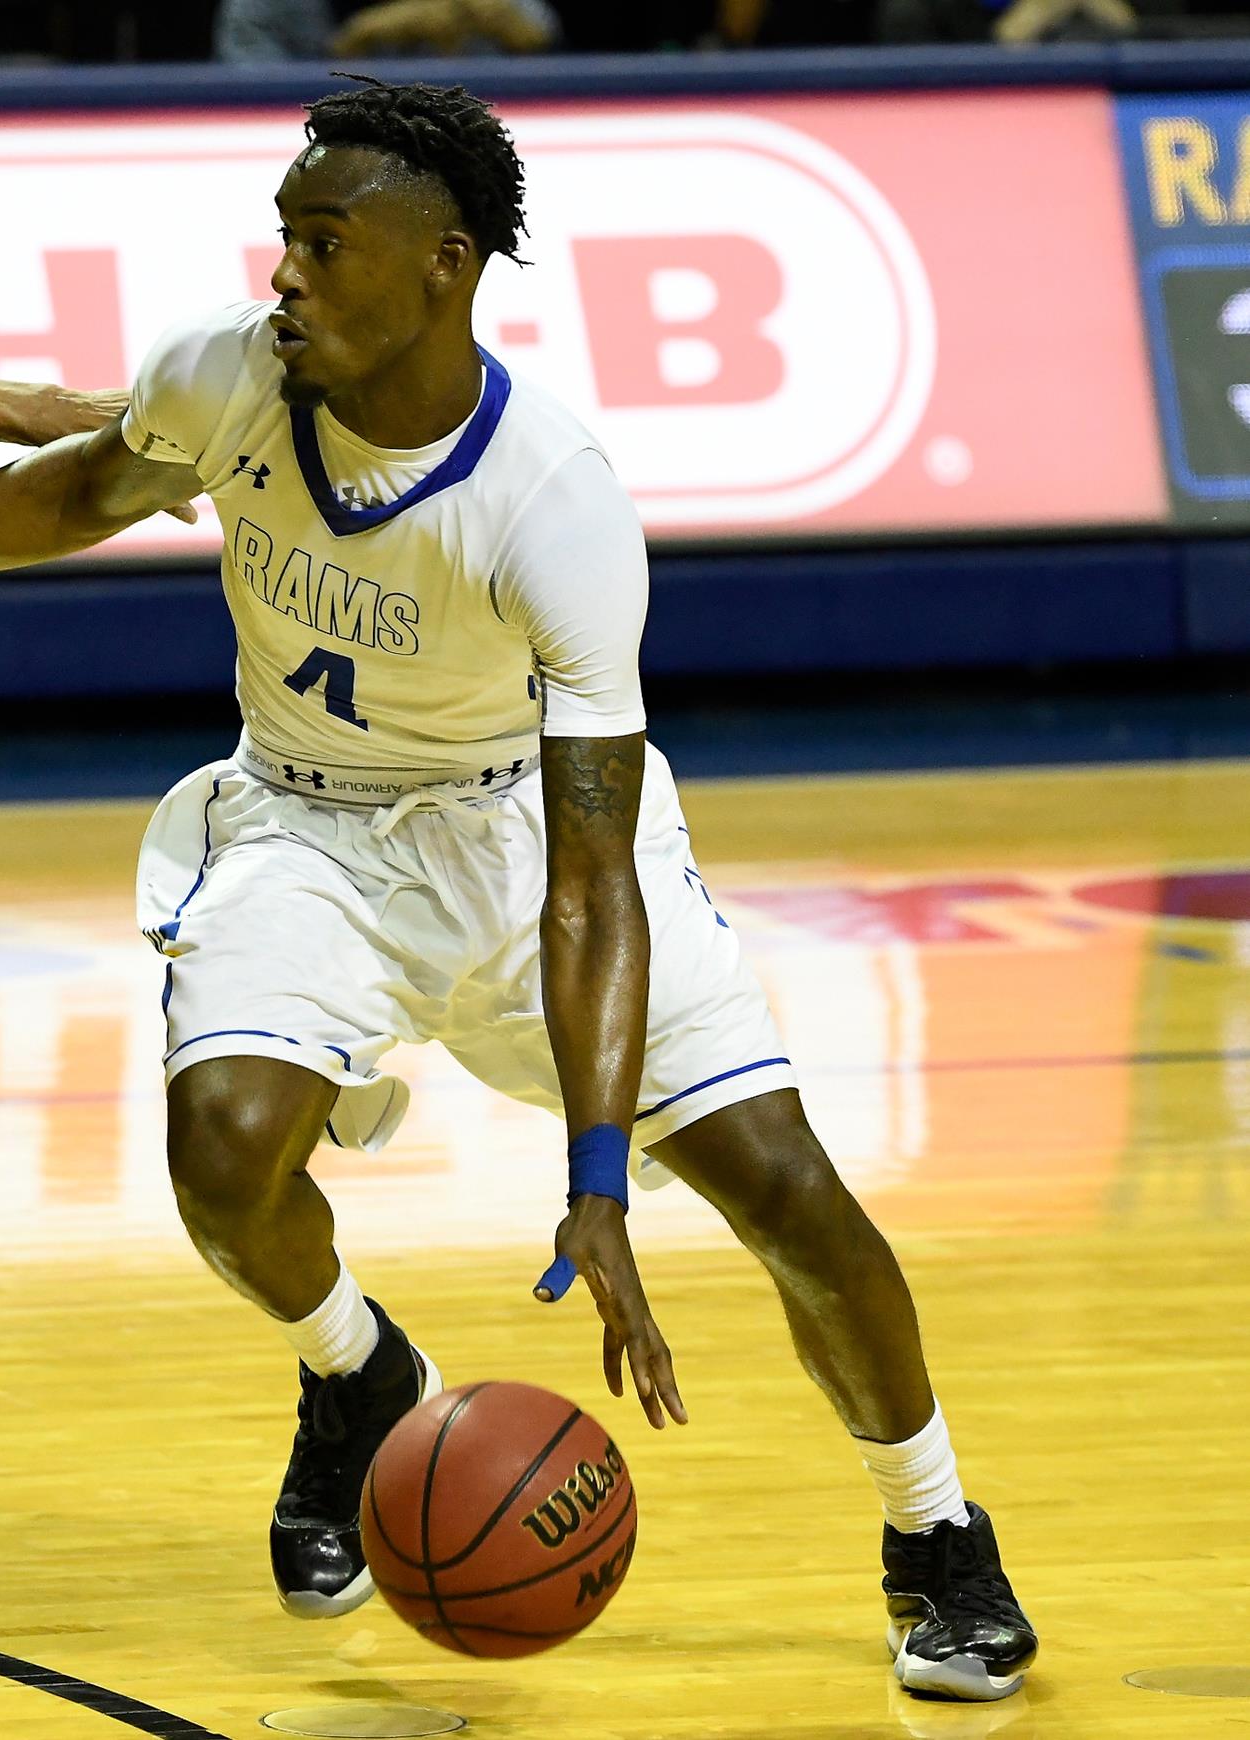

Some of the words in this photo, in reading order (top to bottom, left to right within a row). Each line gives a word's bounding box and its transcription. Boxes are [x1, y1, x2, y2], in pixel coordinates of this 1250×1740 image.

[234, 516, 420, 656] RAMS
[283, 645, 370, 733] 4
[331, 779, 405, 794] ARMOUR
[519, 1437, 624, 1550] Wilso
